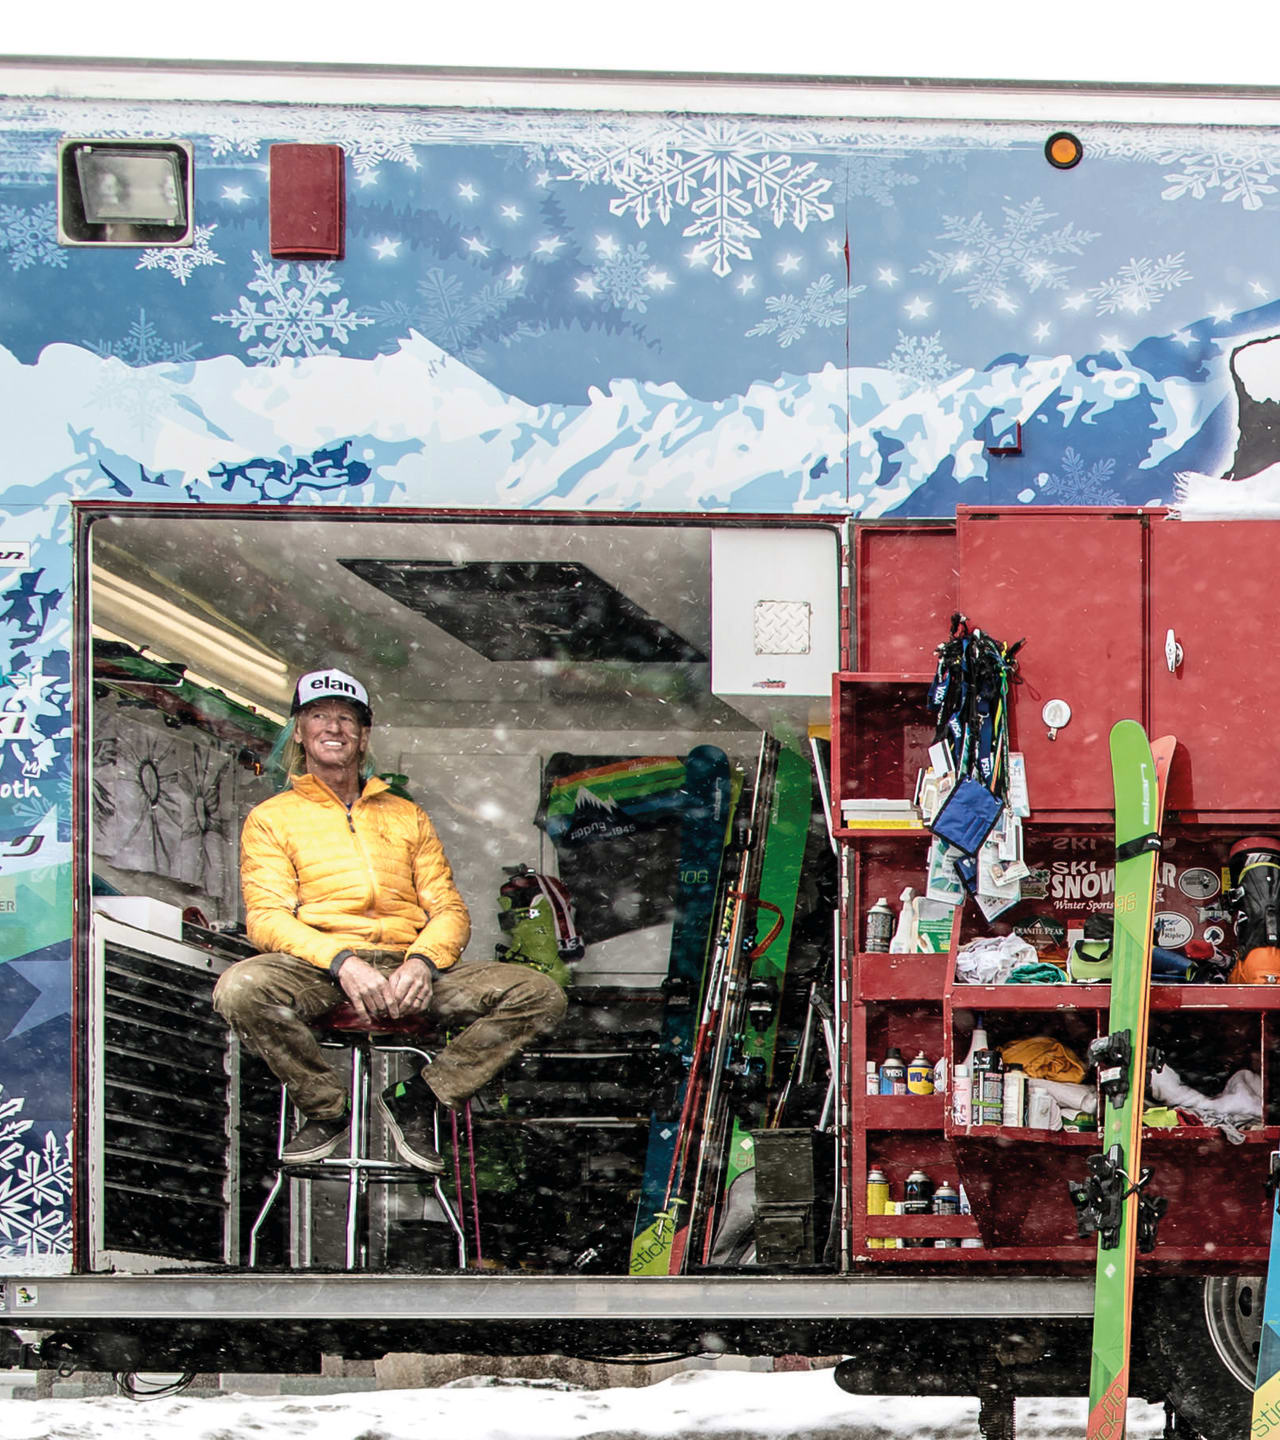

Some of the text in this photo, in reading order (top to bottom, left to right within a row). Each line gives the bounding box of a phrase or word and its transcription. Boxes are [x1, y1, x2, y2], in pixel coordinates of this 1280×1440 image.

[310, 675, 357, 696] elan
[934, 686, 947, 704] VISA
[950, 718, 962, 738] VISA
[980, 758, 991, 778] VISA
[679, 869, 709, 885] 106
[1051, 860, 1097, 875] SKI
[1053, 899, 1114, 913] Winter Sports
[1115, 893, 1136, 914] 96
[1044, 927, 1064, 936] PEAK
[629, 1234, 672, 1273] stick
[1102, 1383, 1126, 1416] rip
